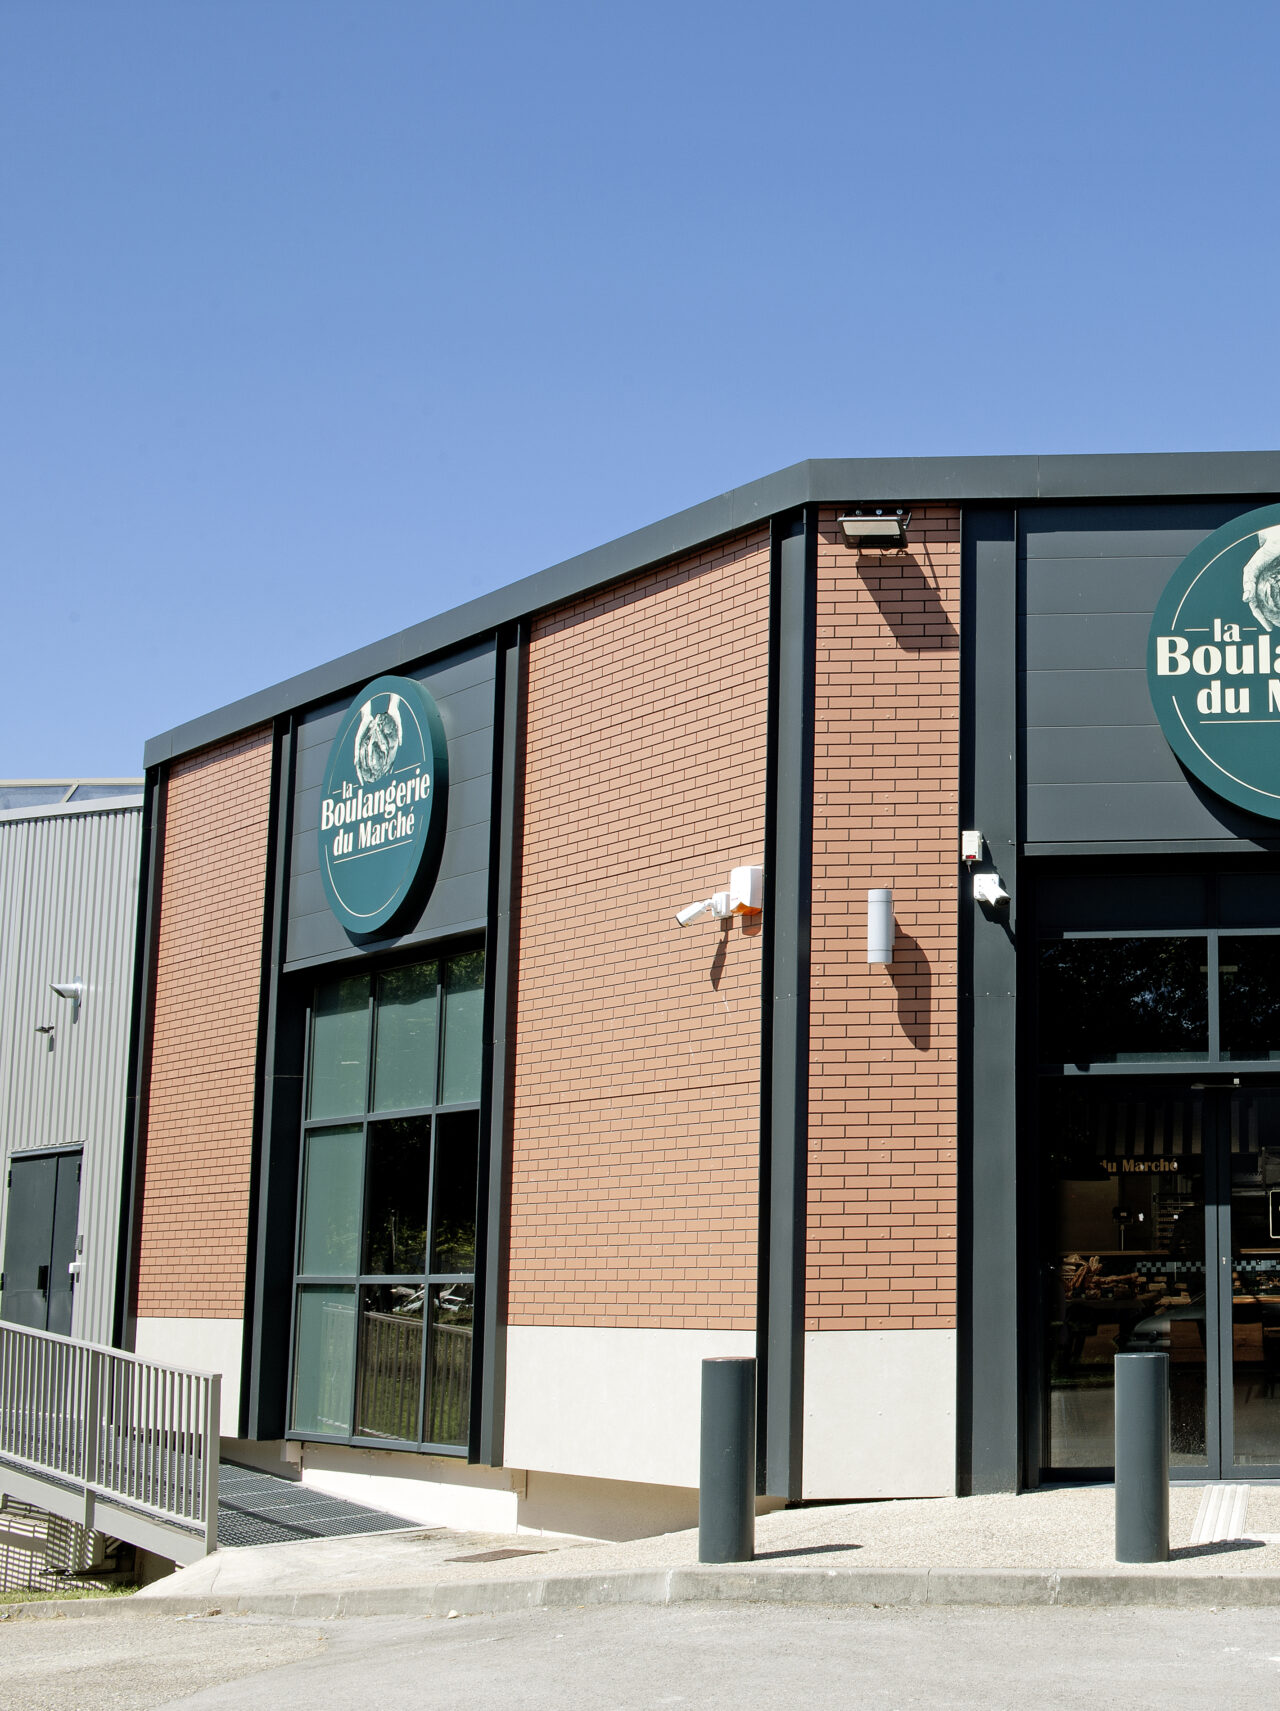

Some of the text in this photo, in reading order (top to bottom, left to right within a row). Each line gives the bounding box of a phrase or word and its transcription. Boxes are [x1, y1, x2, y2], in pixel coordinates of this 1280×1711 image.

[1214, 618, 1242, 642] la
[1196, 680, 1250, 714] du
[320, 768, 430, 831] Boulangerie
[342, 780, 353, 800] la
[333, 806, 414, 856] du Marché
[1122, 1158, 1179, 1172] Marché
